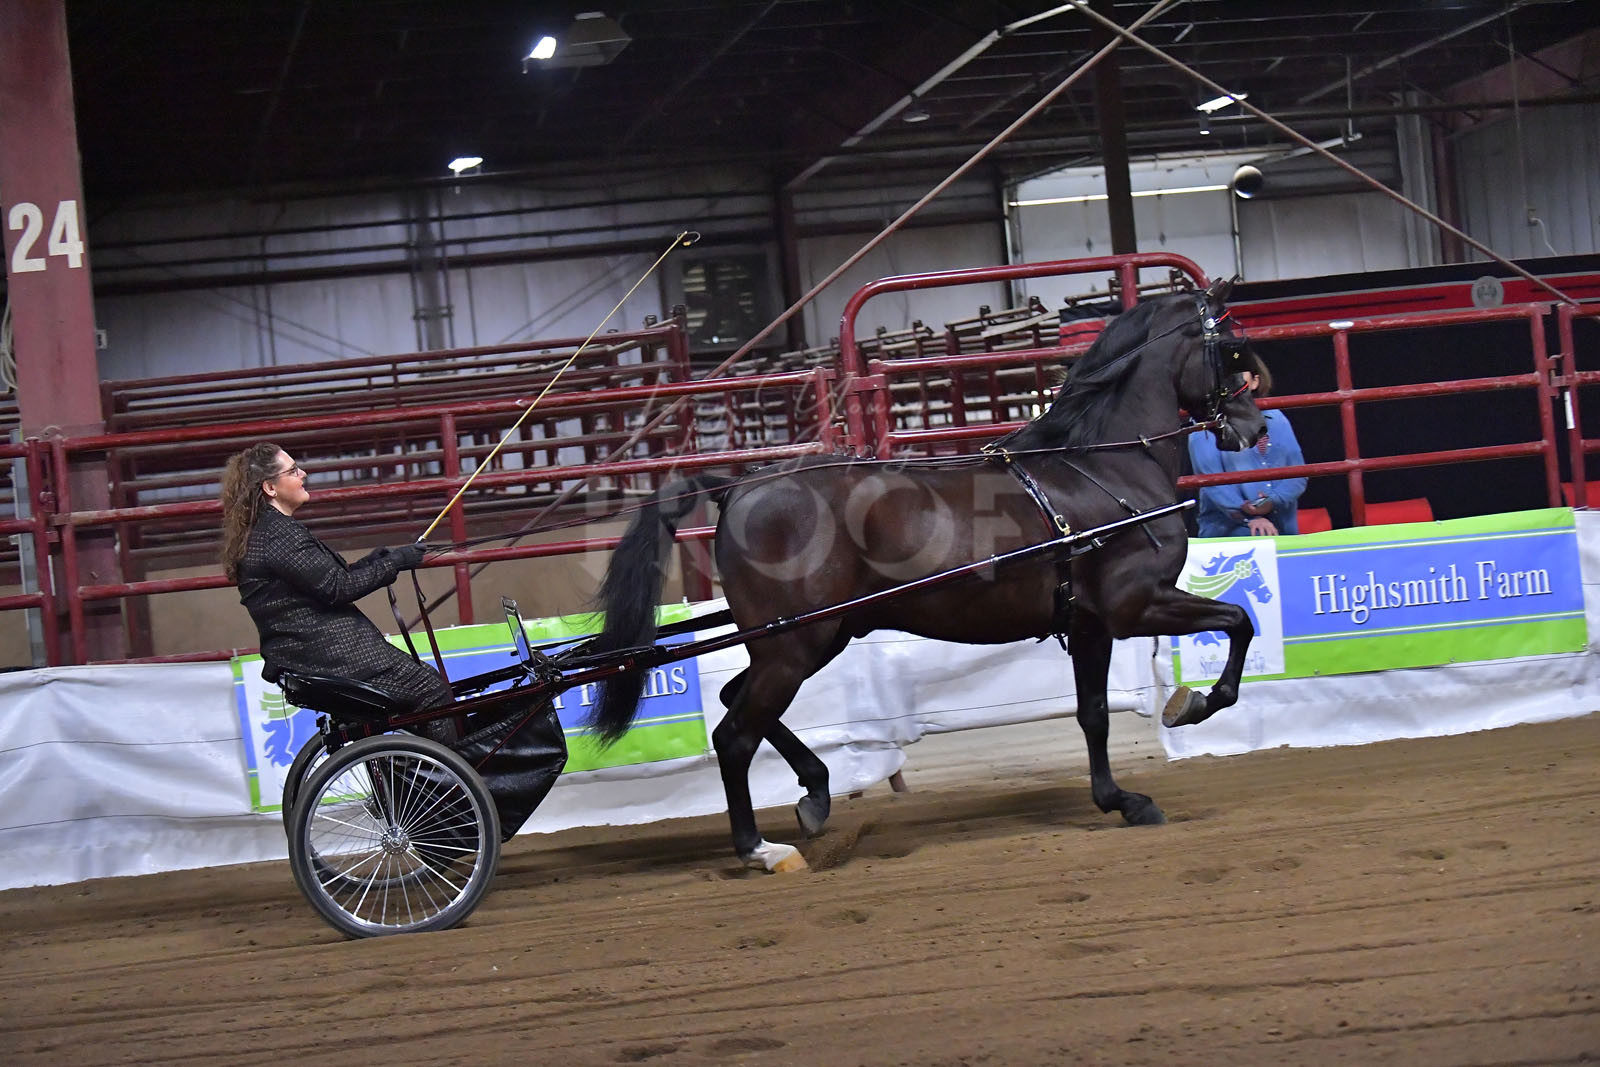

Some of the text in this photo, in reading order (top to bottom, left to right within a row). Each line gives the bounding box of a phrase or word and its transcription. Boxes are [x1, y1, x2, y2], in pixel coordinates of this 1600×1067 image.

[8, 200, 84, 273] 24
[1310, 560, 1553, 624] Highsmith Farm
[576, 665, 688, 706] Fms
